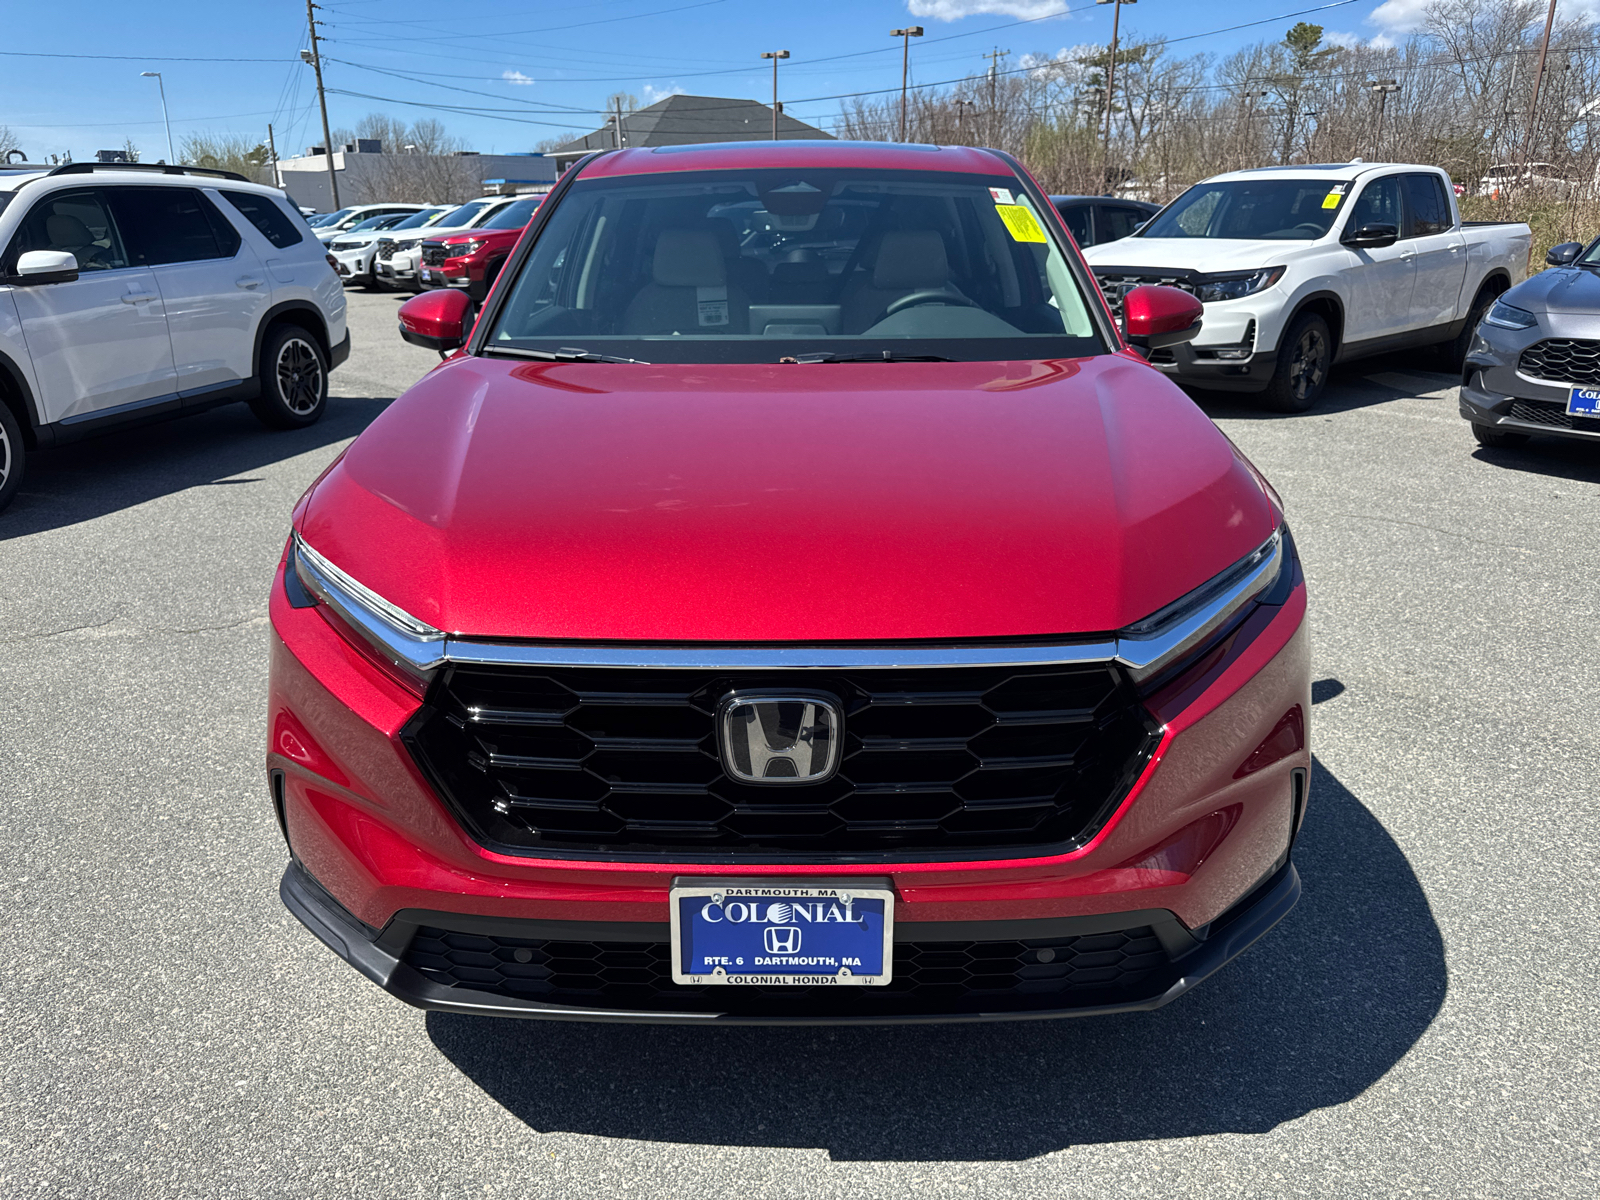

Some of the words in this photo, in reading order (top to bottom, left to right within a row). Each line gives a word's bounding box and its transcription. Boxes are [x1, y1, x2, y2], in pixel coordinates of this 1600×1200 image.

[725, 888, 813, 897] DARTMOUTH,
[818, 889, 838, 897] MA
[701, 902, 864, 924] COLONIAL
[704, 956, 733, 965] RTE.
[735, 956, 744, 965] 6
[754, 956, 839, 967] DARTMOUTH,
[842, 957, 861, 966] MA
[726, 976, 789, 984] COLONIAL
[792, 976, 838, 985] HONDA
